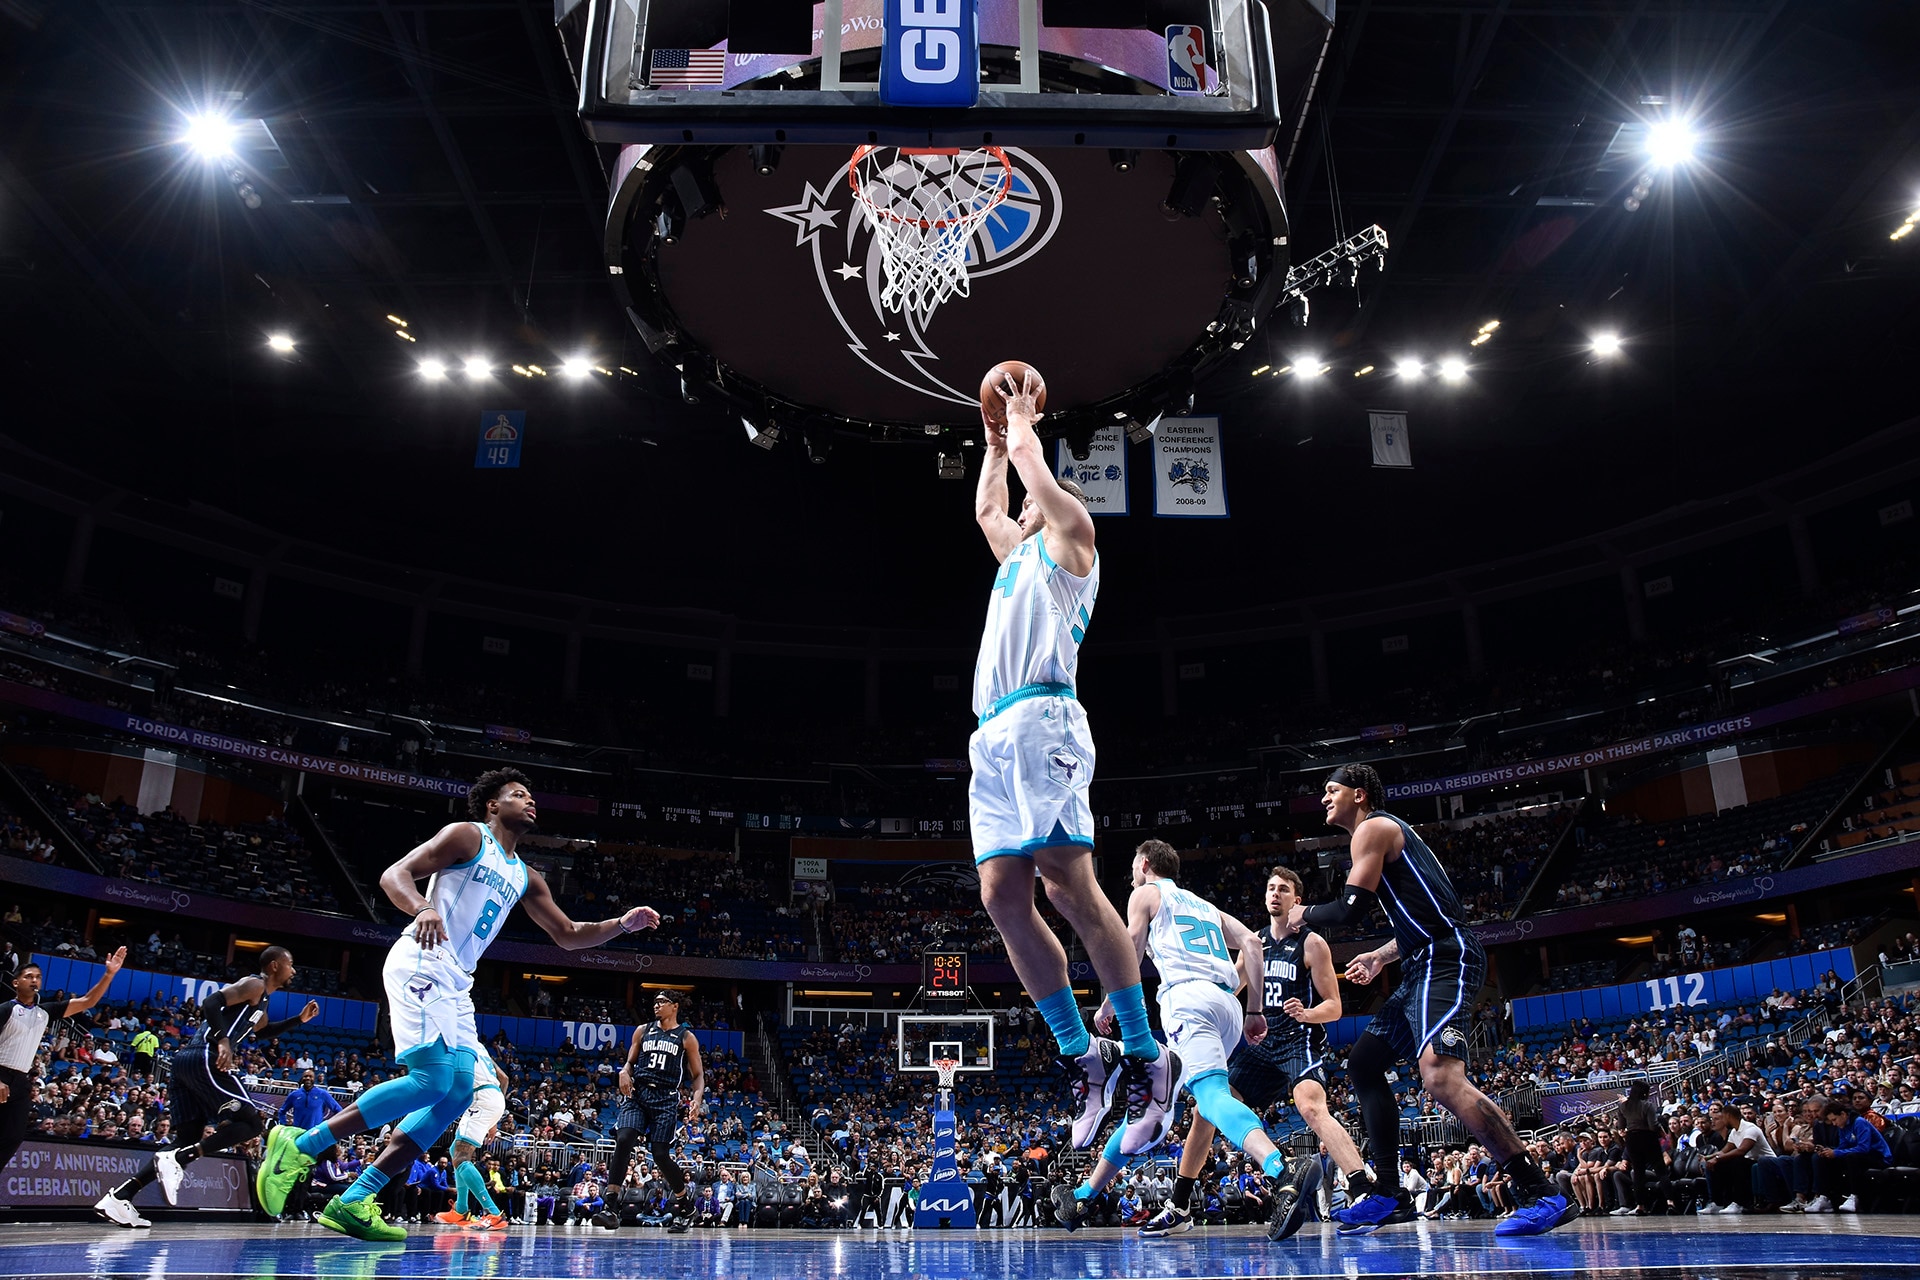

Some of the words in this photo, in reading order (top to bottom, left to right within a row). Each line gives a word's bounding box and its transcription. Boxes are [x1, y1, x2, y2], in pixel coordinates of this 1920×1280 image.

[1174, 76, 1193, 88] NBA
[1159, 436, 1214, 444] CONFERENCE
[488, 447, 509, 465] 49
[1163, 446, 1211, 454] CHAMPIONS
[126, 717, 189, 742] FLORIDA
[192, 733, 267, 758] RESIDENTS
[270, 751, 300, 765] CAN
[301, 755, 336, 773] SAVE
[338, 764, 360, 776] ON
[362, 768, 407, 784] THEME
[408, 776, 443, 792] PARK
[1387, 782, 1443, 798] FLORIDA
[1445, 768, 1514, 790] RESIDENTS
[1516, 762, 1545, 777] CAN
[1547, 757, 1582, 771] SAVE
[1583, 750, 1605, 764] ON
[1606, 739, 1652, 759] THEME
[1653, 730, 1692, 749] PARK
[1693, 716, 1752, 739] TICKETS
[666, 813, 677, 821] 0-2
[746, 820, 760, 828] FOULS
[763, 815, 769, 828] 0
[795, 816, 802, 828] 7
[918, 819, 944, 832] 10:25
[952, 820, 965, 831] 1ST
[1103, 815, 1109, 827] 0
[1134, 814, 1141, 826] 7
[1707, 891, 1736, 901] Disney
[1735, 886, 1754, 897] World
[1753, 876, 1774, 899] 50
[121, 886, 151, 904] Disney
[170, 891, 190, 912] 50
[473, 899, 502, 941] 8
[1174, 915, 1229, 961] 20
[1516, 920, 1533, 940] 50
[635, 954, 652, 972] 50
[934, 956, 961, 967] 10:25
[1071, 962, 1089, 979] 50
[1263, 960, 1297, 981] LANDO
[814, 967, 838, 979] Disney
[855, 964, 871, 982] 50
[933, 968, 958, 987] 24
[182, 977, 233, 1007] 10
[1265, 981, 1282, 1006] 22
[1646, 972, 1708, 1011] 112
[562, 1020, 617, 1051] 109
[642, 1040, 679, 1056] ORLANDO
[648, 1053, 667, 1070] 34
[22, 1151, 50, 1169] 50TH
[54, 1153, 141, 1174] ANNIVERSARY
[7, 1177, 100, 1197] CELEBRATION
[204, 1176, 223, 1190] World
[222, 1163, 240, 1201] 50
